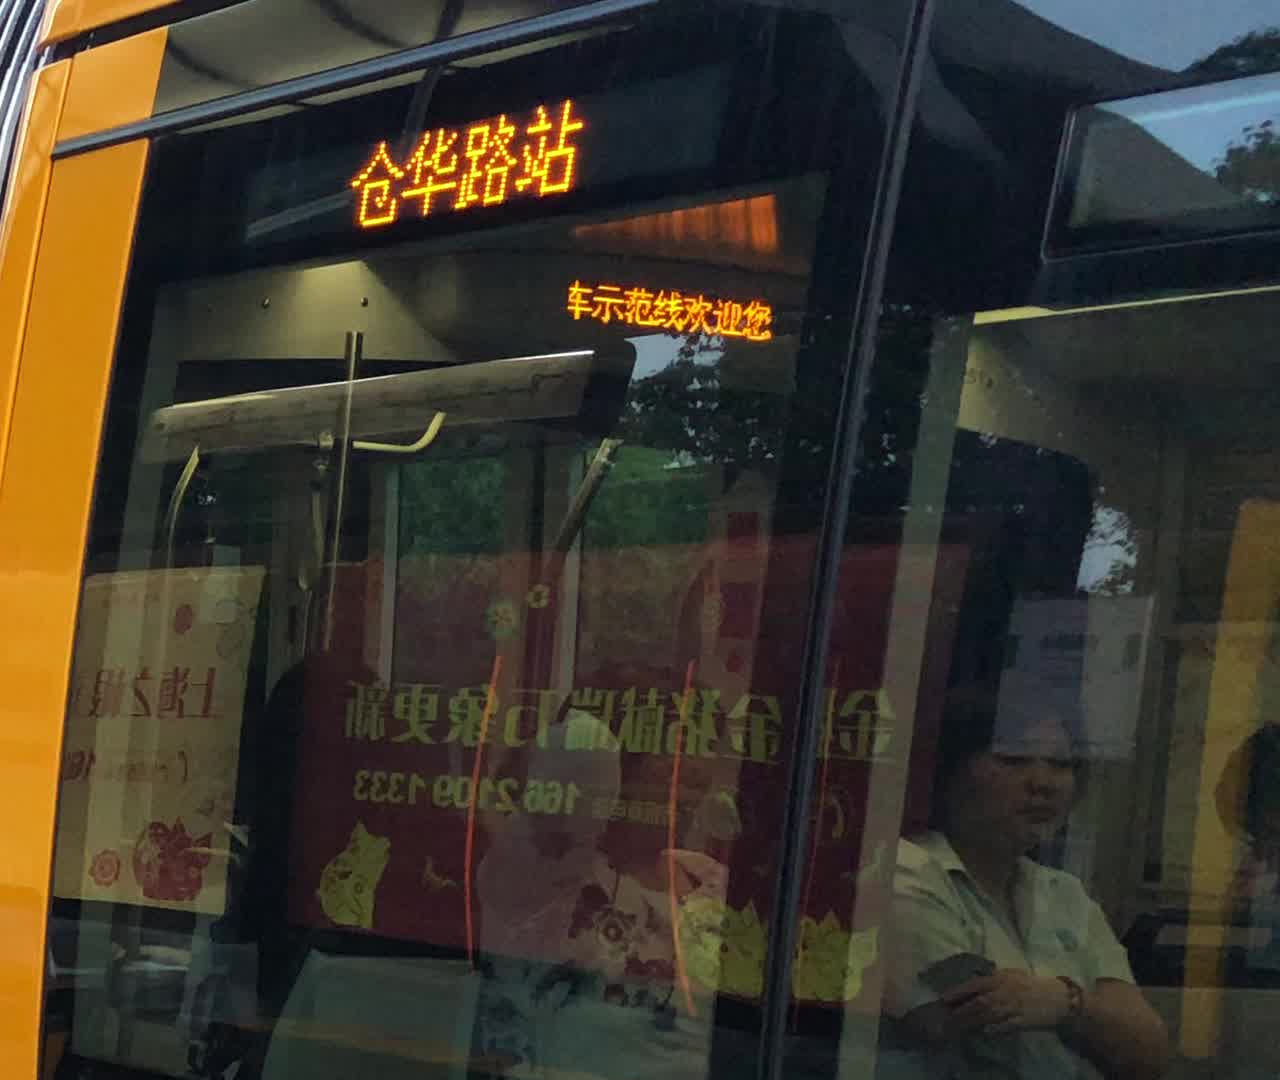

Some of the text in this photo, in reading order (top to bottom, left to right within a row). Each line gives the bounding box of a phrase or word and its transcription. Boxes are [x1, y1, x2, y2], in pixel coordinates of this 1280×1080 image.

[351, 99, 586, 229] 仓华路站
[566, 280, 773, 343] 车示范线欢迎您
